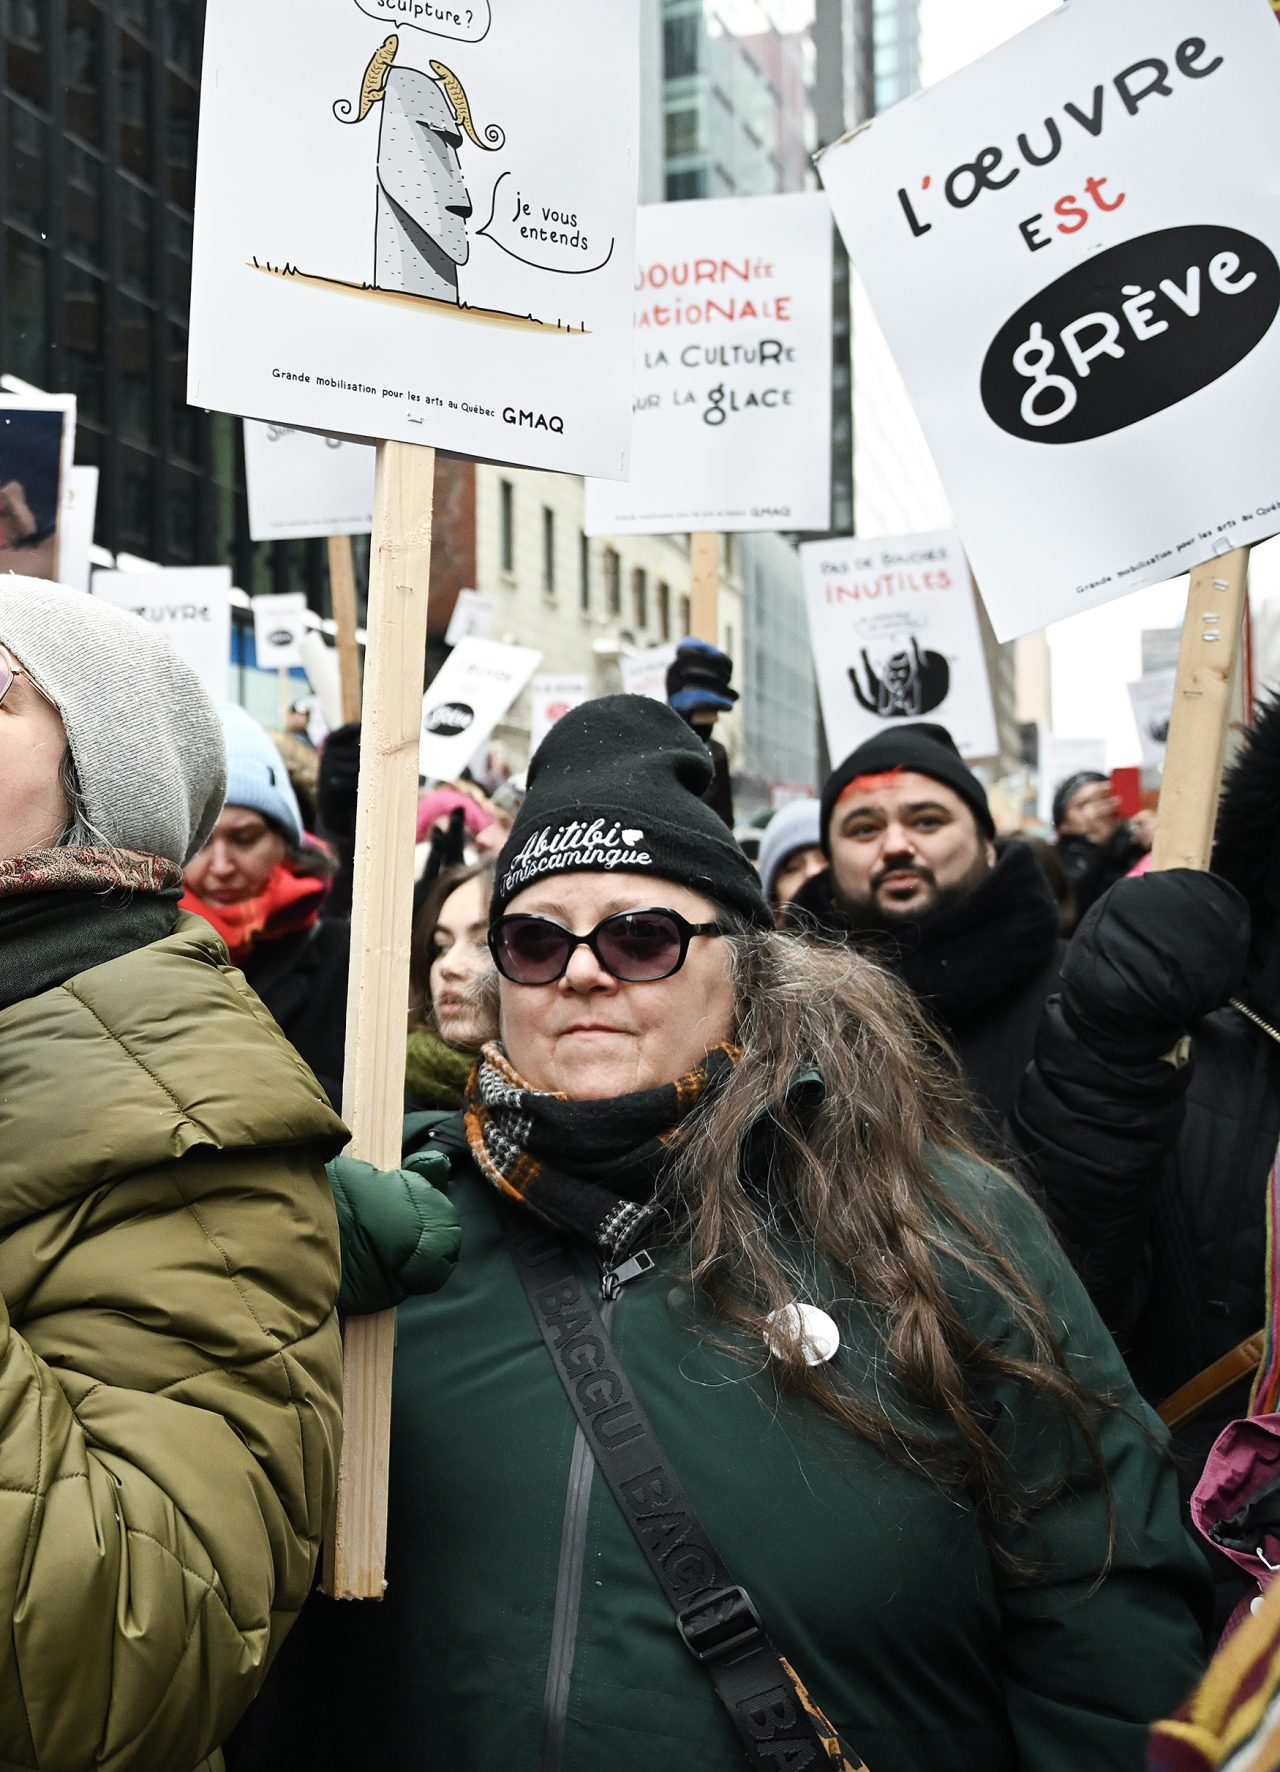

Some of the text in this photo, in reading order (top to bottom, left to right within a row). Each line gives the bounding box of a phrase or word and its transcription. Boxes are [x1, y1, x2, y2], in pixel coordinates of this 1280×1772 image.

[512, 191, 577, 228] je vous
[520, 226, 588, 250] entends
[645, 350, 668, 368] LA
[272, 368, 564, 435] Grande mobilisation pour les arts au Québec GMAQ
[673, 390, 697, 406] LA
[510, 818, 622, 869] Abitibi
[535, 1275, 647, 1451] BAGGU
